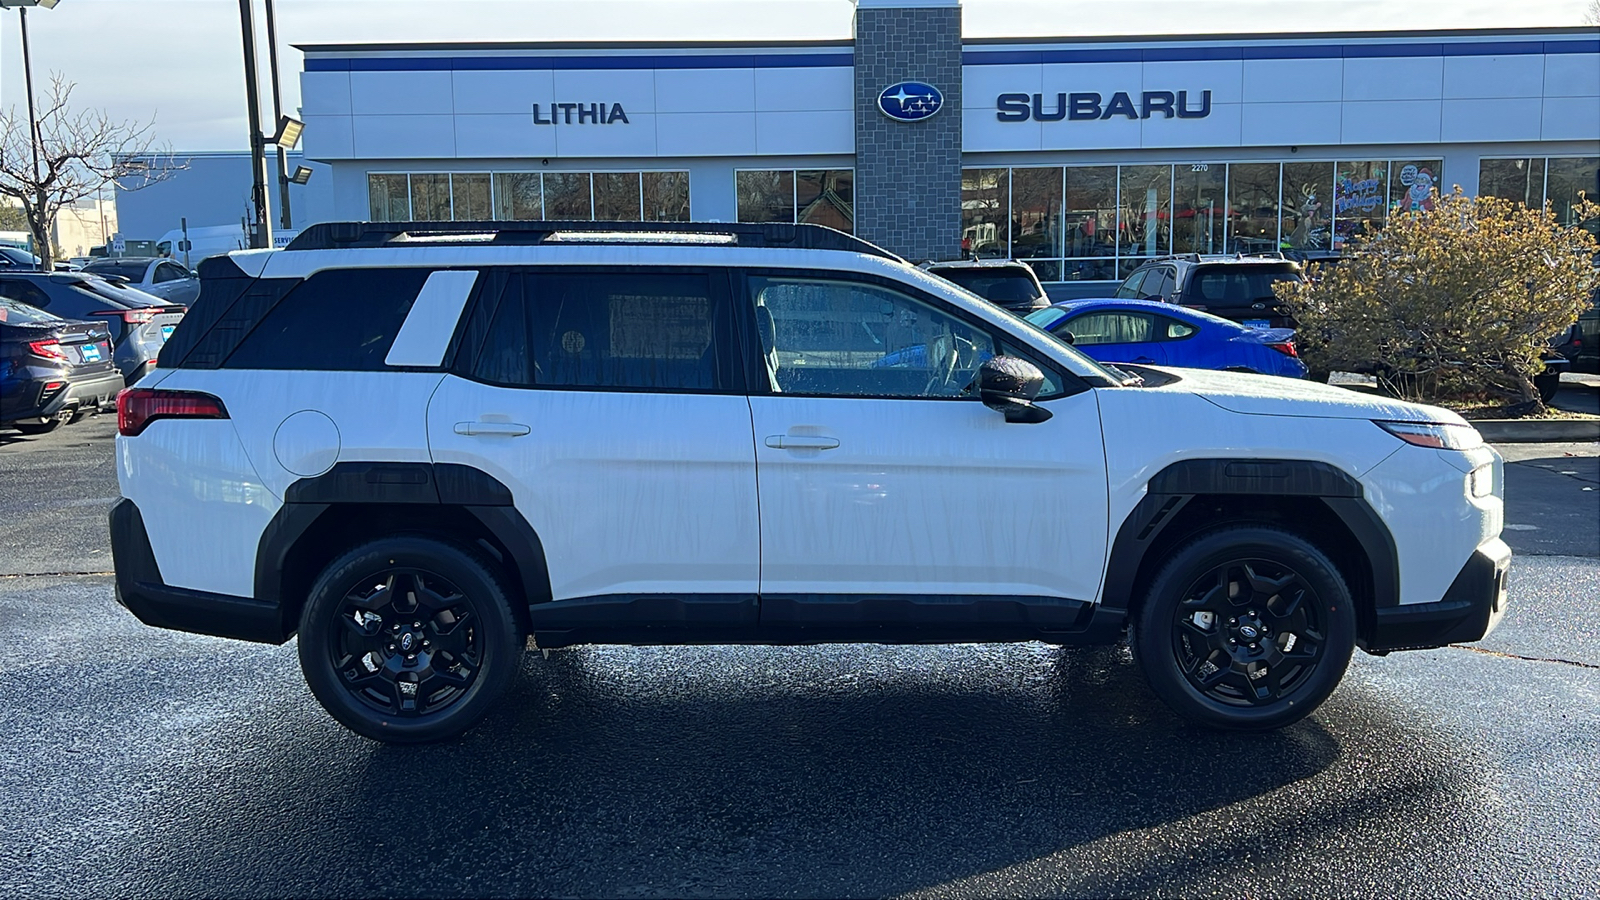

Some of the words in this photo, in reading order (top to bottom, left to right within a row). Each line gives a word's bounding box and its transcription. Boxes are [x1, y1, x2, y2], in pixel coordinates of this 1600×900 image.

[532, 102, 630, 125] LITHIA
[996, 90, 1212, 122] SUBARU
[1191, 164, 1208, 172] 2270
[1341, 178, 1379, 195] Happy
[1336, 193, 1383, 213] Holidays
